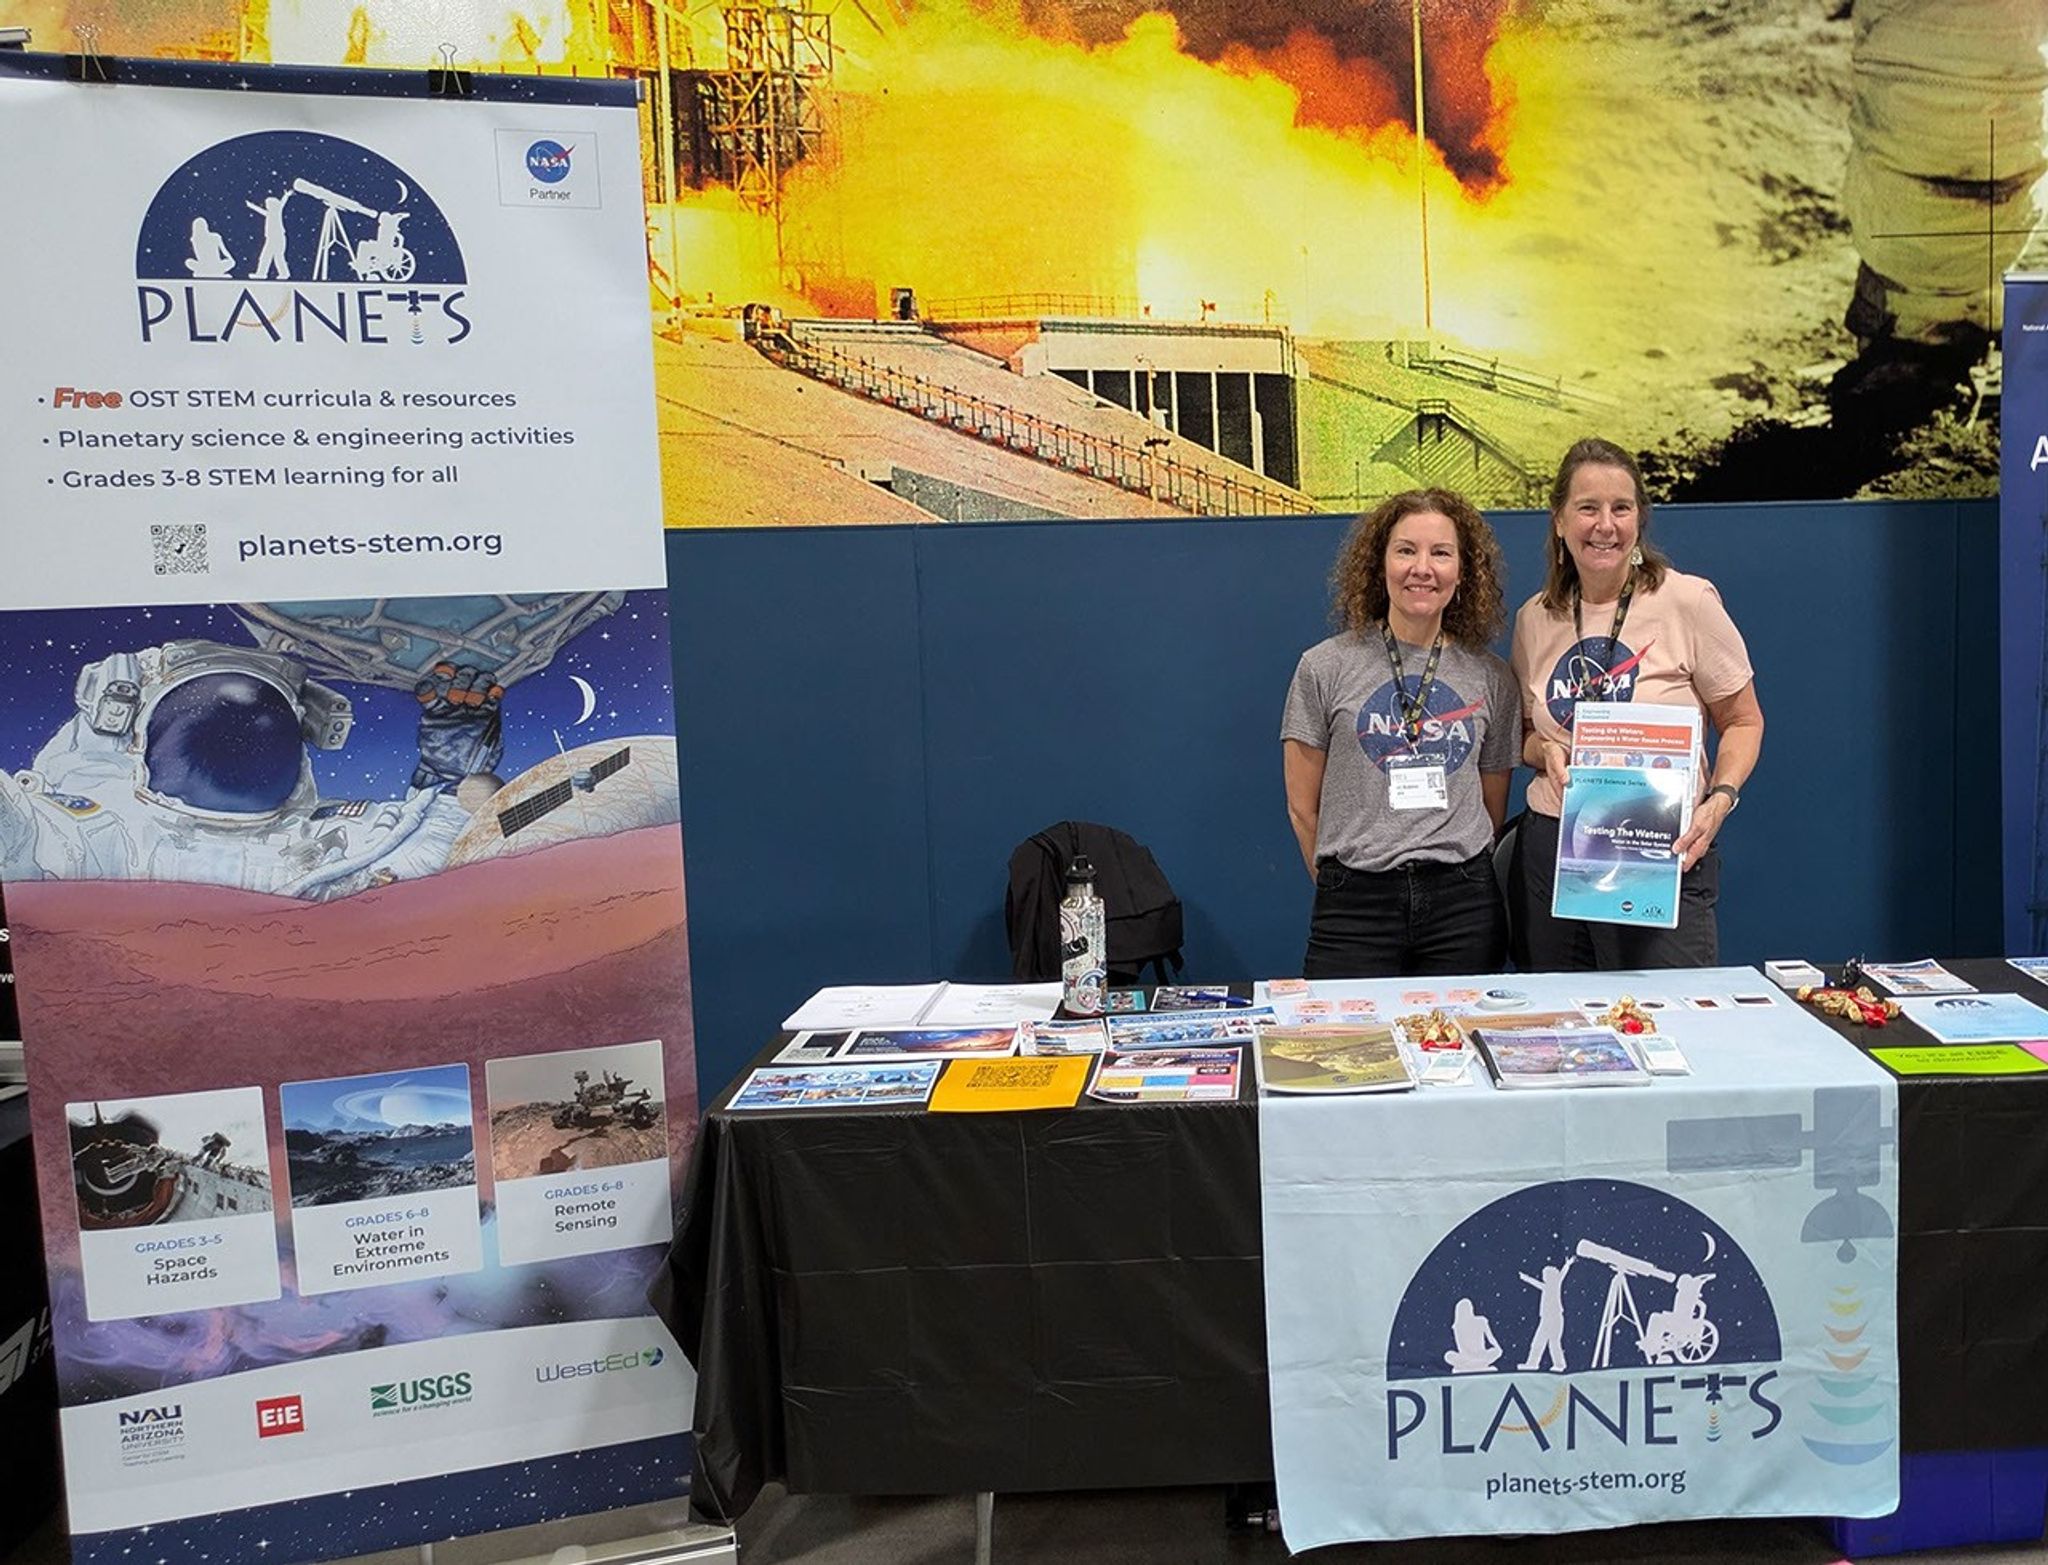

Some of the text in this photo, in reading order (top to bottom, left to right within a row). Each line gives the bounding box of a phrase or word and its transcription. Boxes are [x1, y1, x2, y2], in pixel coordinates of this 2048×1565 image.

[529, 156, 569, 168] NASA
[529, 188, 571, 200] Partner
[137, 285, 472, 345] PLANETS
[53, 387, 517, 408] Free OST STEM curricula & resources
[58, 427, 575, 451] Planetary science & engineering activities
[63, 466, 458, 488] Grades 3-8 STEM learning for all
[238, 533, 502, 562] planets-stem.org
[1583, 825, 1672, 840] Testing The Waters:
[544, 1183, 599, 1200] GRADES
[555, 1199, 616, 1217] Remote
[345, 1211, 403, 1228] GRADES
[555, 1214, 618, 1233] Sensing
[135, 1236, 197, 1254] GRADES
[353, 1225, 425, 1246] Water in
[355, 1240, 425, 1260] Extreme
[154, 1254, 208, 1273] Space
[333, 1250, 450, 1277] Environments
[147, 1266, 218, 1286] Hazards
[536, 1351, 640, 1384] WestEd
[400, 1372, 472, 1404] USGS
[119, 1405, 182, 1426] NAU
[260, 1404, 300, 1427] EiE
[1386, 1370, 1783, 1461] PLANETS
[120, 1419, 183, 1435] NORTHERN
[121, 1427, 184, 1443] ARIZONA
[121, 1436, 185, 1450] UNIVERSITY
[1486, 1469, 1687, 1500] planets-stem.org
